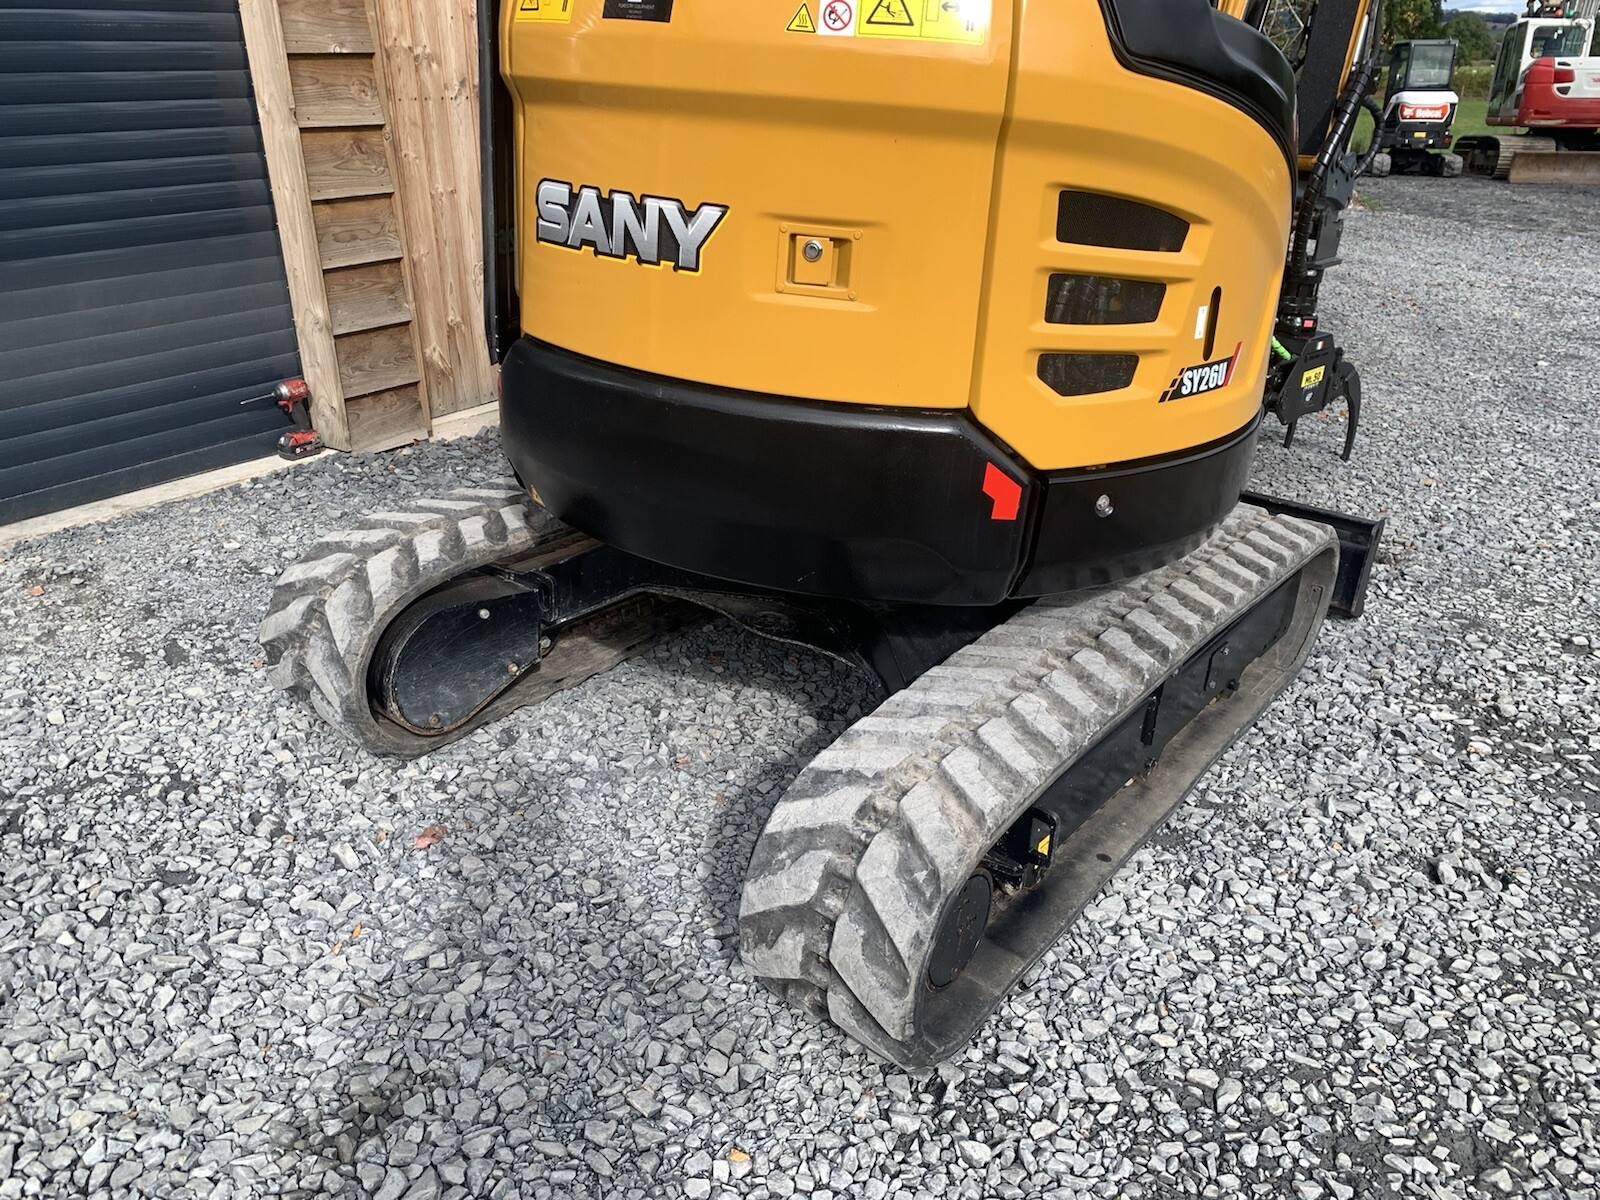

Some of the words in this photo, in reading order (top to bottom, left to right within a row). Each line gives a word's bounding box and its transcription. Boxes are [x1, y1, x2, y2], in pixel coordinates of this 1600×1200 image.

[1415, 108, 1443, 119] Bobcat
[537, 179, 727, 270] SANY
[1181, 361, 1228, 395] SY26U
